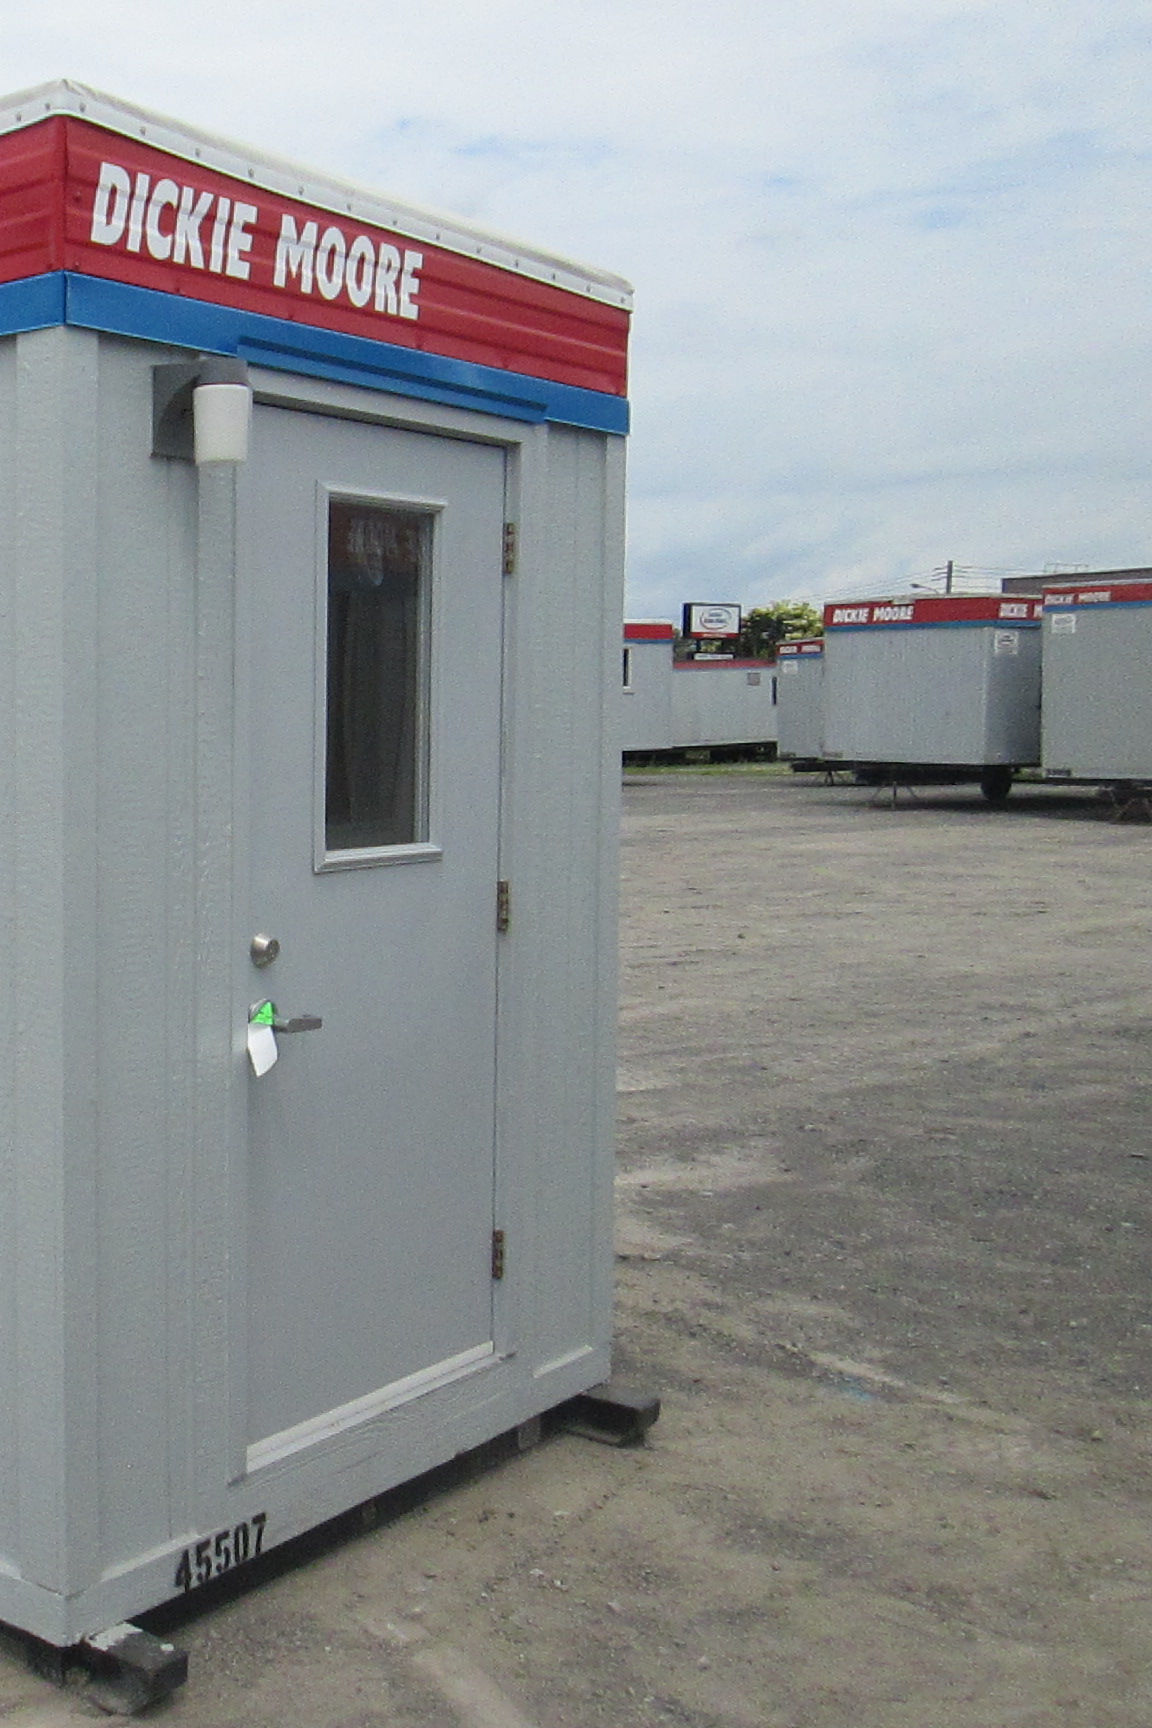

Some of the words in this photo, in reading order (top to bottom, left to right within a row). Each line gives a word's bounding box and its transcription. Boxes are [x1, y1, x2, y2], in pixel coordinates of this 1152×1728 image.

[90, 161, 258, 280] DICKIE
[273, 213, 424, 321] MOORE
[174, 1511, 266, 1593] 45507
